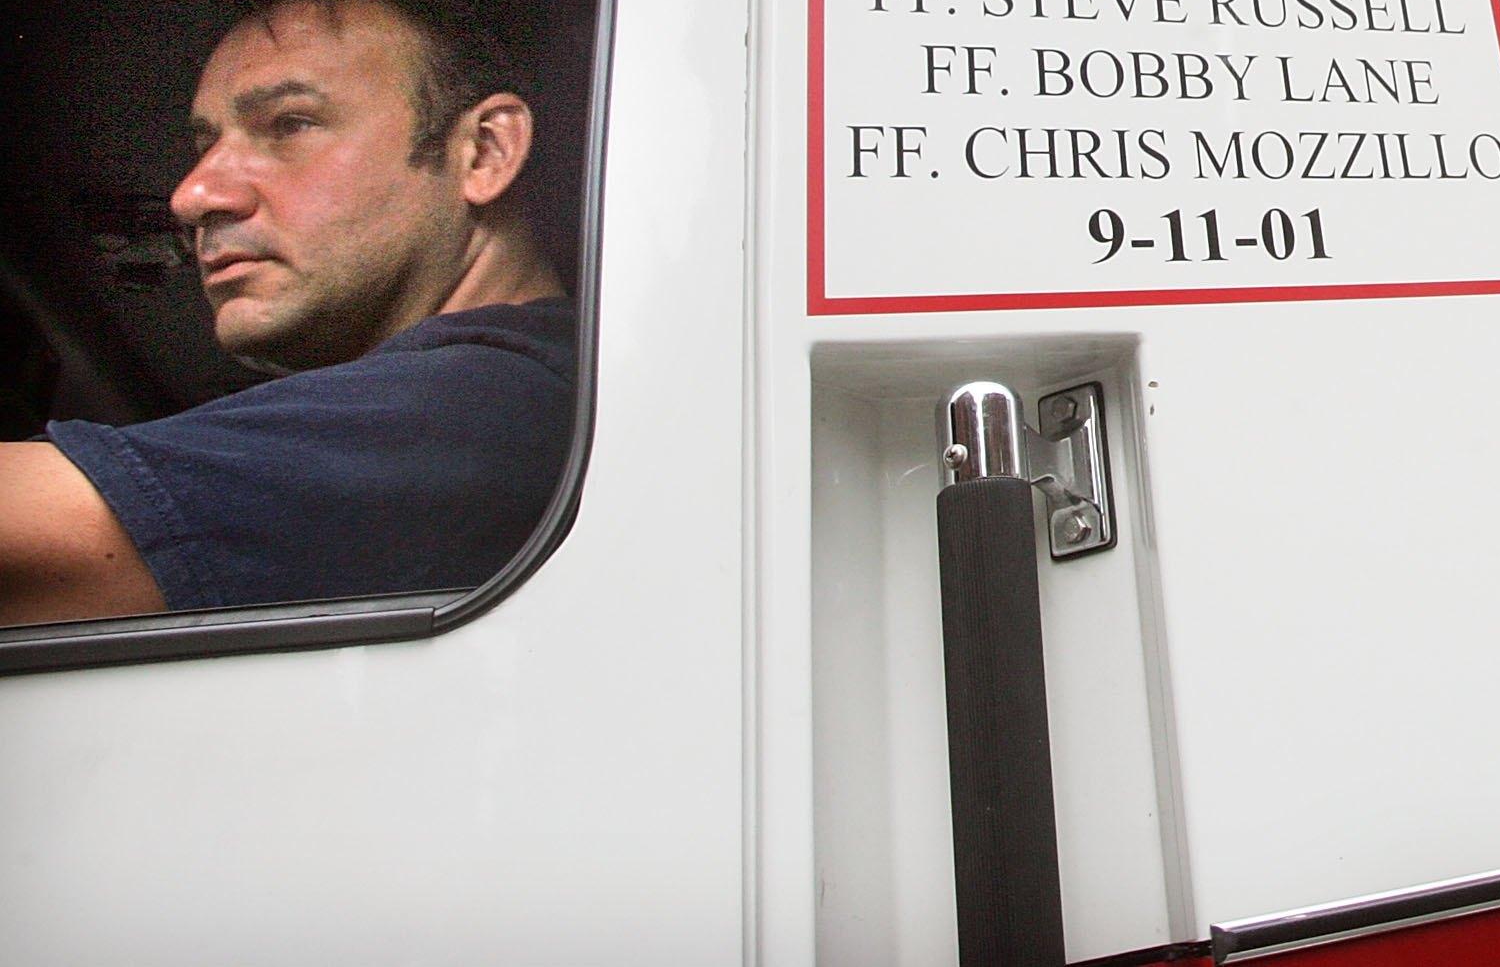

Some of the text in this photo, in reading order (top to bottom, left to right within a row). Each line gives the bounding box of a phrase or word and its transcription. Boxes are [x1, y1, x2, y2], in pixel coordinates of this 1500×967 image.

[921, 45, 1440, 105] FF. BOBBY LANE
[846, 125, 939, 179] FF.
[964, 127, 1171, 180] CHRIS
[1088, 207, 1332, 265] 9-11-01
